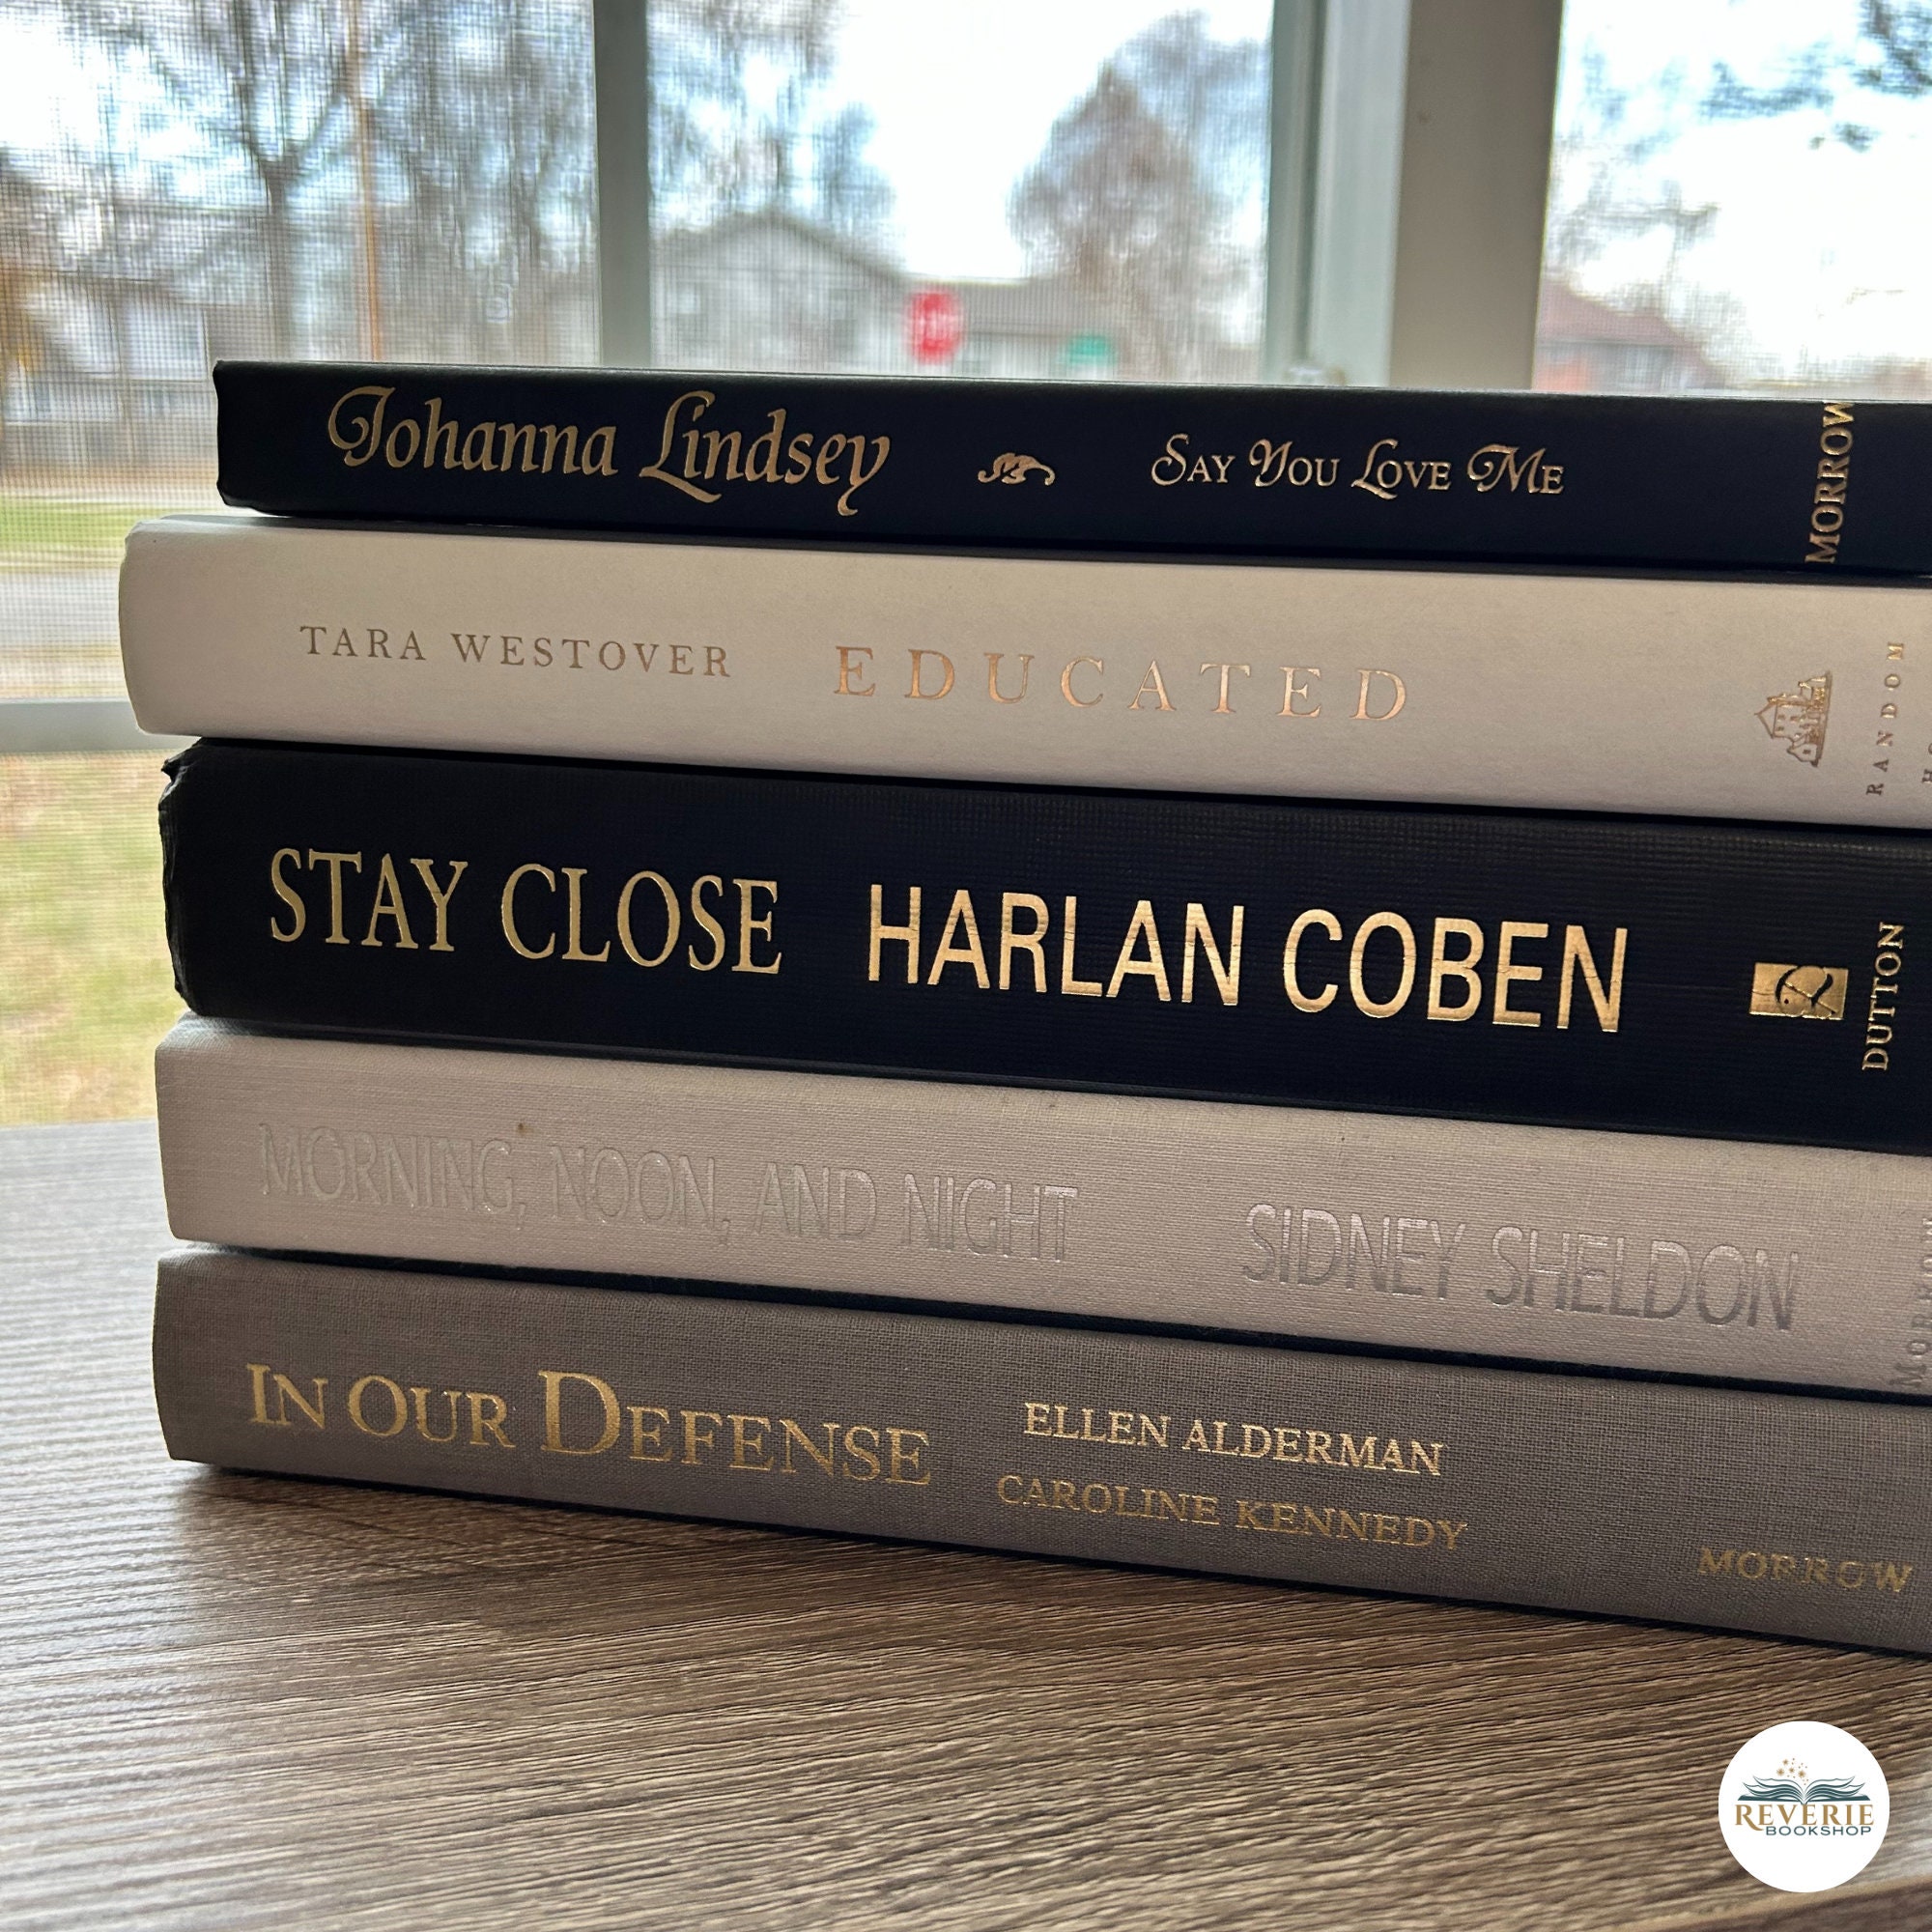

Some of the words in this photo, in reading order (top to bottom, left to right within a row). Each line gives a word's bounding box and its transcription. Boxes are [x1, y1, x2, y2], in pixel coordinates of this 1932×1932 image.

[327, 385, 619, 476] Johanna
[639, 390, 891, 516] Lindsey
[1804, 402, 1855, 563] MORROW
[298, 625, 427, 662] TARA
[451, 632, 731, 677] WESTOVER
[834, 645, 1406, 721] EDUCATED
[1865, 641, 1904, 795] RANDOM
[270, 848, 468, 952] STAY
[501, 864, 782, 975] CLOSE
[868, 884, 1244, 1006] HARLAN
[1283, 909, 1628, 1032] COBEN
[1861, 922, 1904, 1071] DUTTON
[258, 1122, 526, 1230] MORNING,
[549, 1144, 731, 1246] NOON,
[754, 1159, 877, 1239] AND
[902, 1173, 1078, 1263] NIGHT
[1241, 1203, 1466, 1299] SIDNEY
[1486, 1226, 1799, 1331] SHELDON
[245, 1363, 327, 1431] IN
[348, 1375, 516, 1448] OUR
[537, 1370, 931, 1486] DEFENSE
[1023, 1401, 1171, 1449] ELLEN
[1182, 1419, 1443, 1476] ALDERMAN
[997, 1475, 1220, 1525] CAROLINE
[1236, 1499, 1468, 1550] KENNEDY
